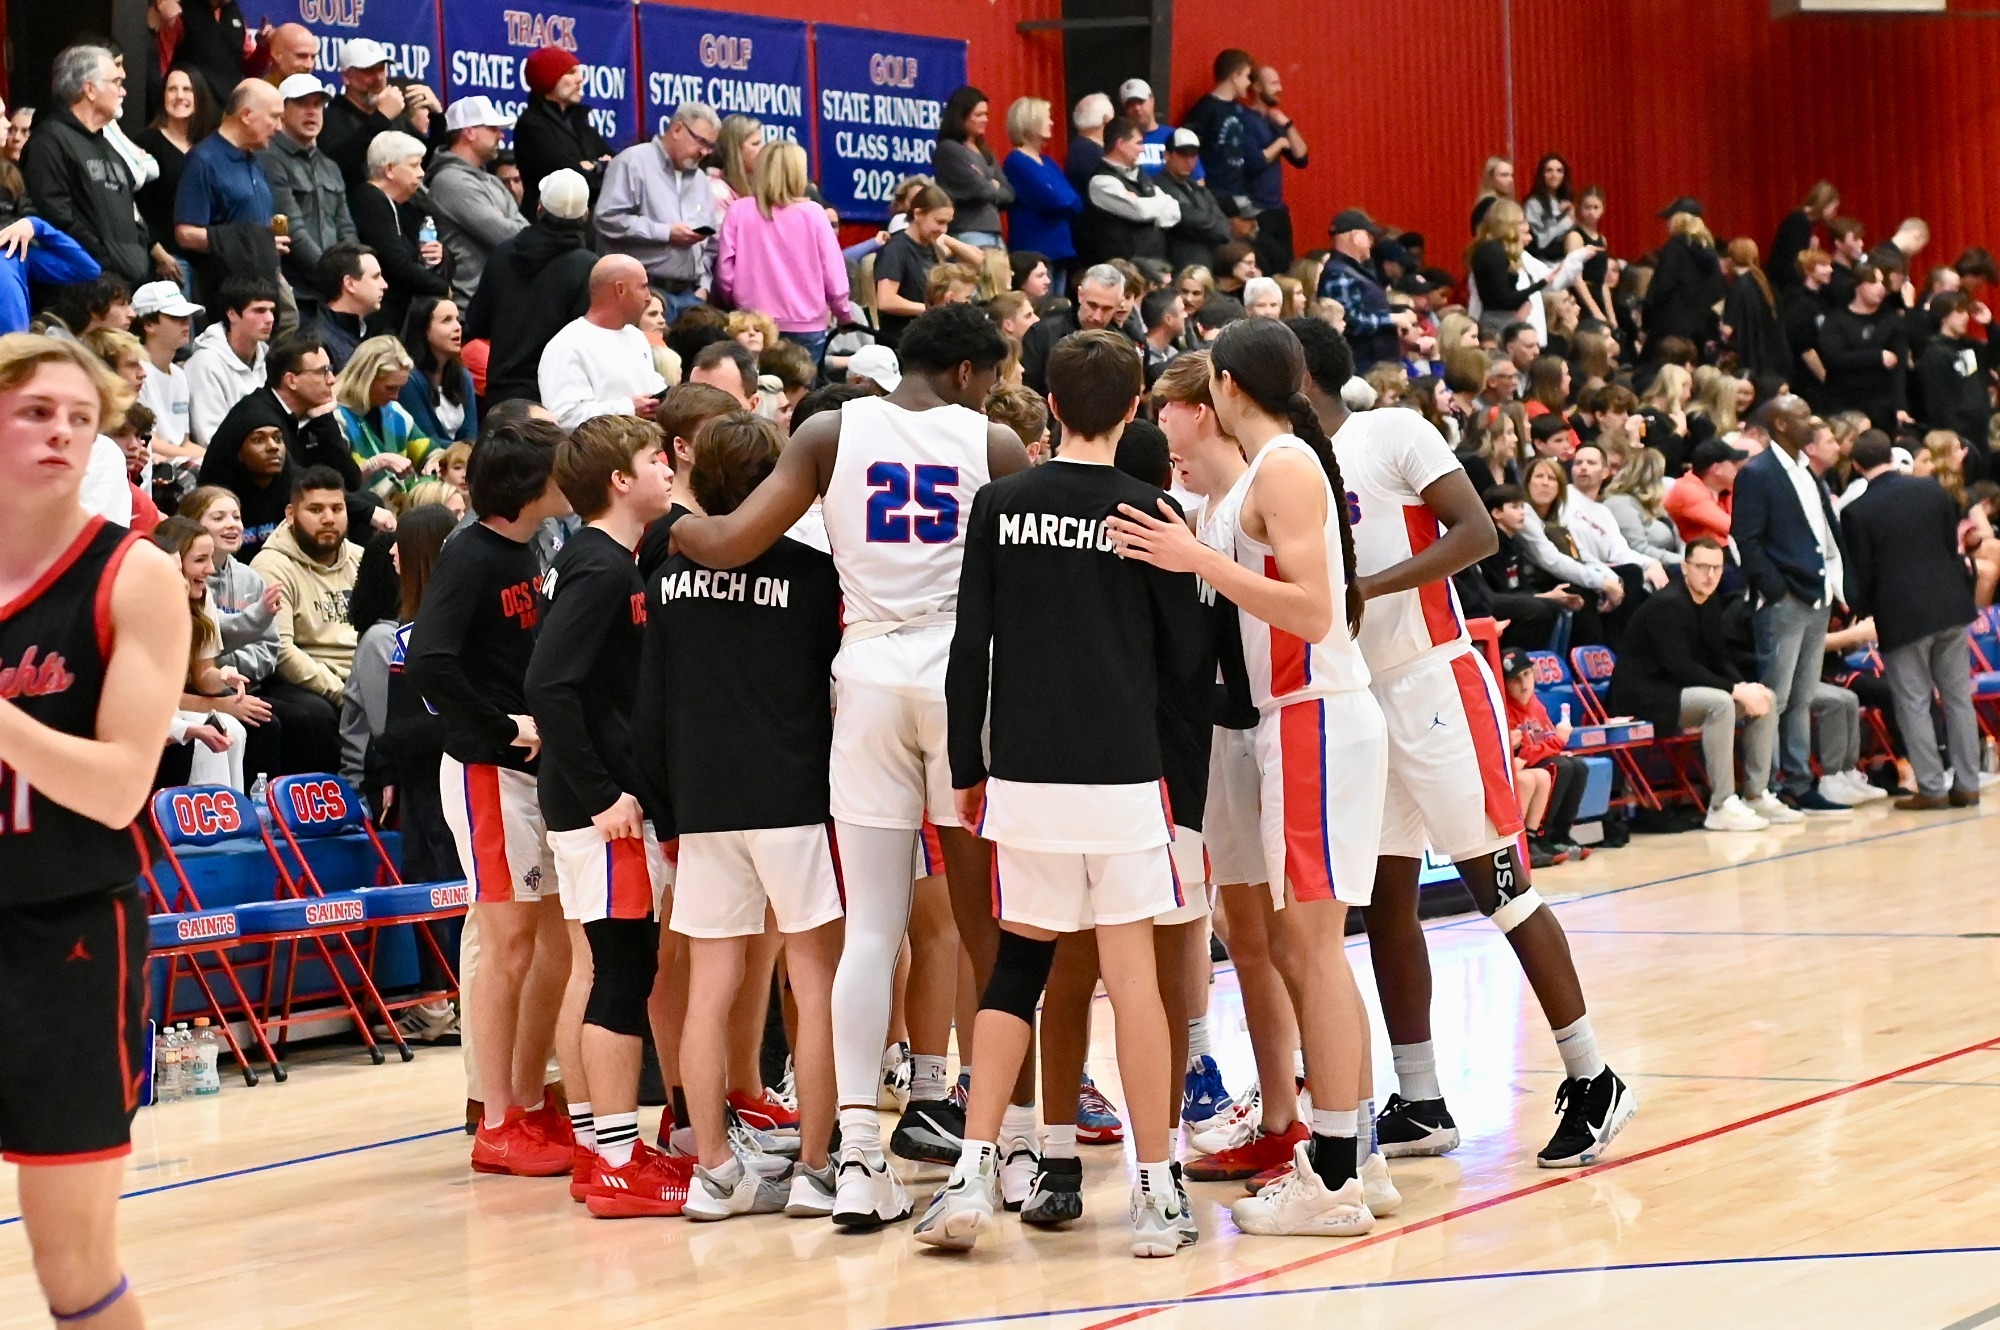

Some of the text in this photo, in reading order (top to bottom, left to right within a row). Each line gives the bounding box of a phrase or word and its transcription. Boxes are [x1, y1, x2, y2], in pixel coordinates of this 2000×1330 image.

[299, 0, 364, 27] GOLF
[503, 10, 578, 52] TRACK
[452, 50, 515, 91] STATE
[700, 33, 752, 71] GOLF
[869, 53, 918, 88] GOLF
[649, 71, 802, 117] STATE CHAMPION
[822, 89, 871, 124] STATE
[835, 130, 888, 162] CLASS
[866, 461, 959, 544] 25
[999, 512, 1097, 550] MARCH
[501, 581, 533, 618] OCS
[661, 569, 790, 608] MARCH ON
[172, 790, 242, 836] OCS
[289, 780, 347, 824] OCS
[306, 899, 364, 925] SAINTS
[430, 885, 470, 908] SAINT
[177, 913, 236, 940] SAINTS
